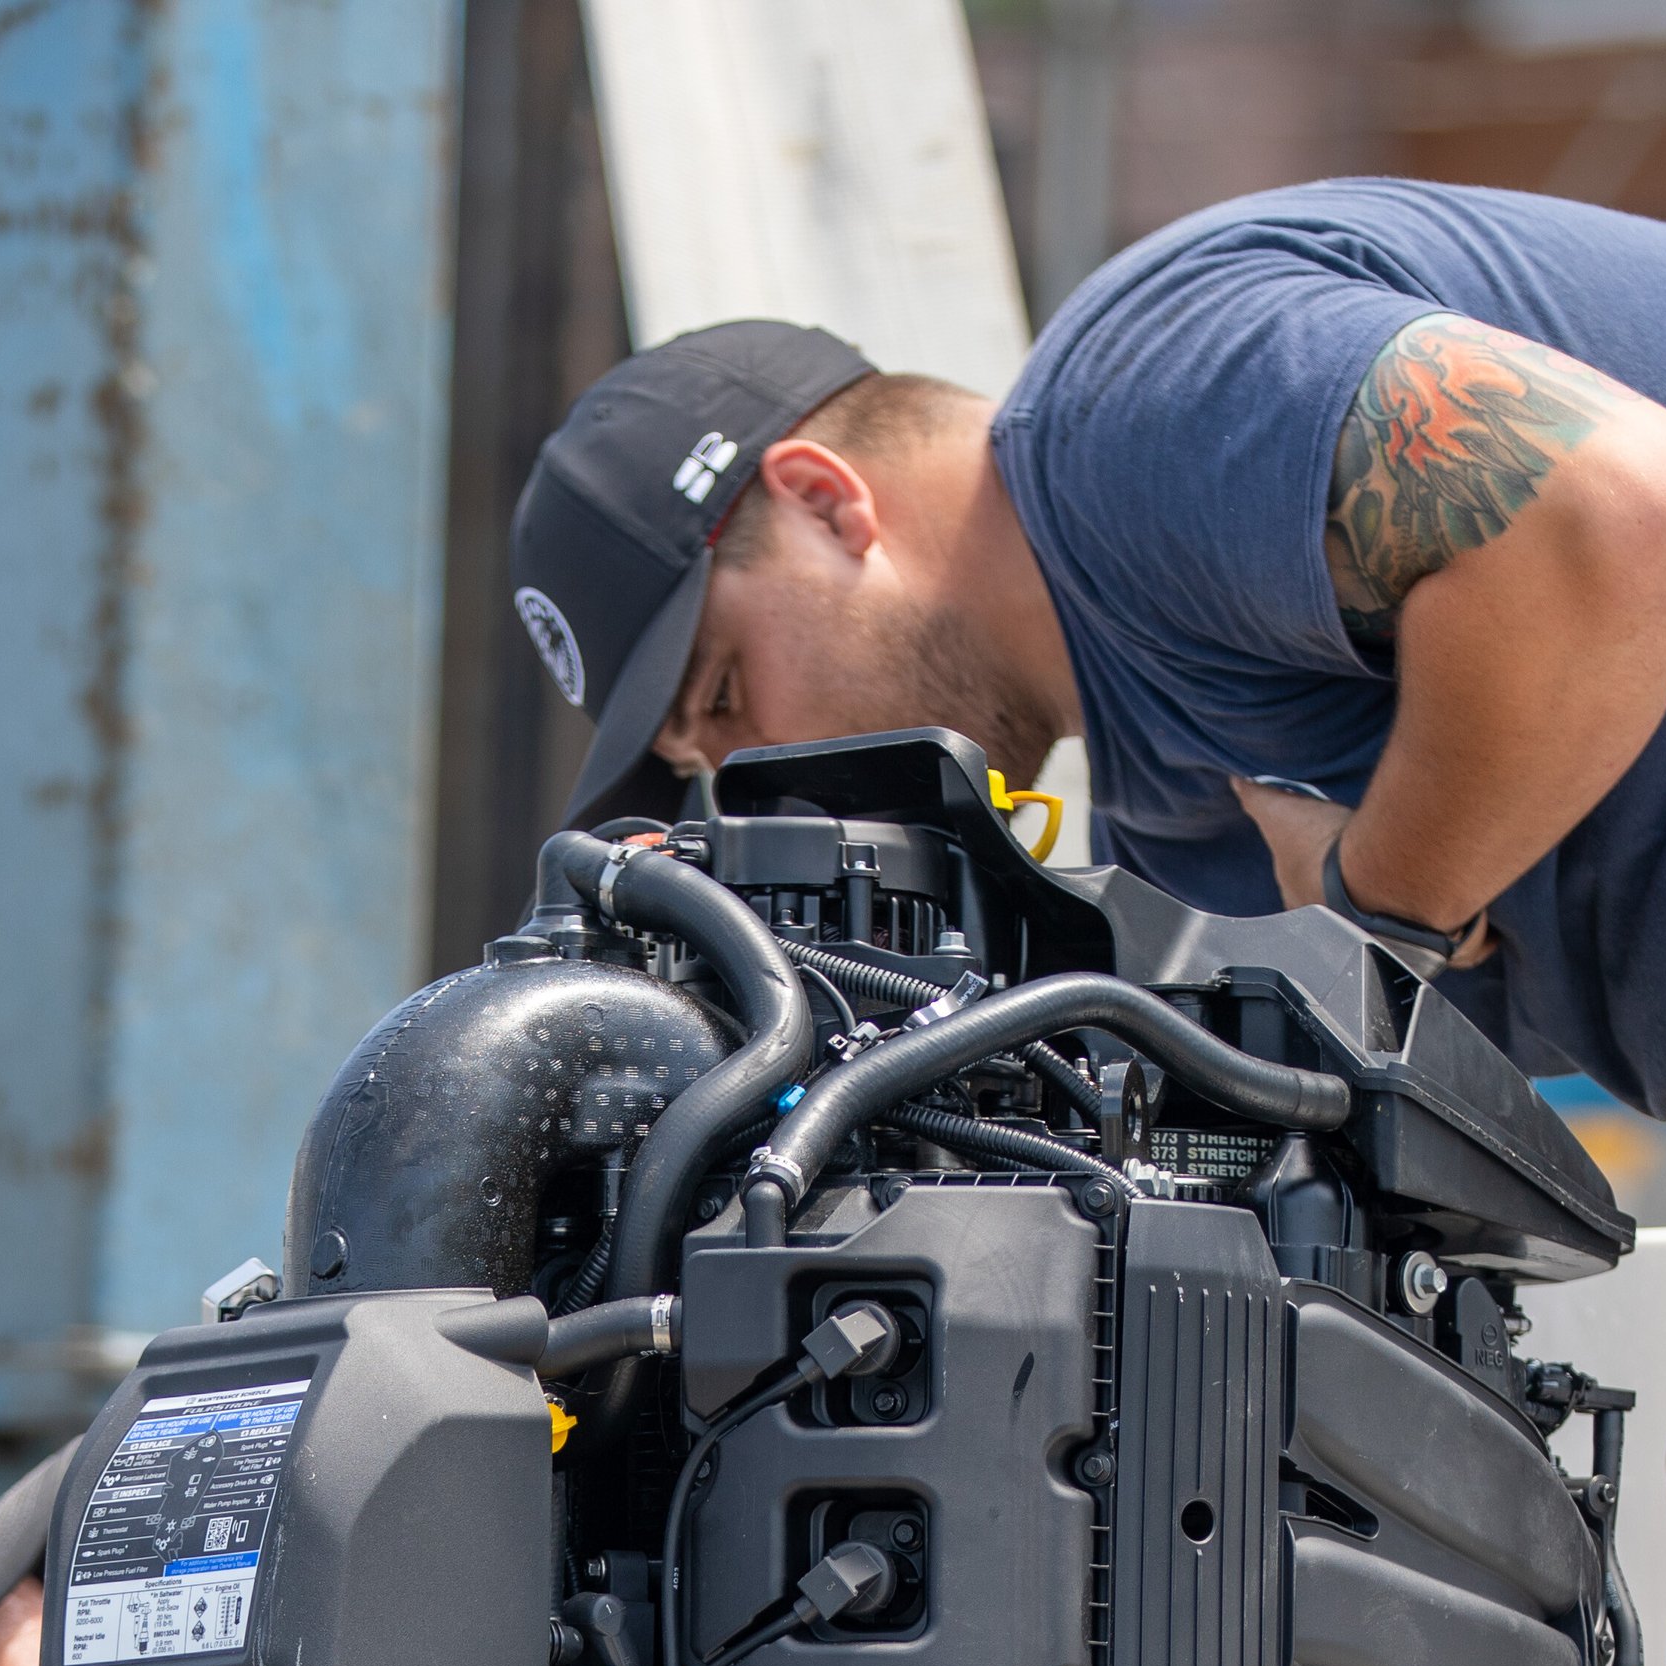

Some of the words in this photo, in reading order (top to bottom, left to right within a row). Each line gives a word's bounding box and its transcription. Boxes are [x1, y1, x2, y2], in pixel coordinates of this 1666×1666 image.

[1151, 1146, 1178, 1160] 373
[1187, 1147, 1258, 1162] STRETCH
[1475, 1348, 1503, 1368] NEG
[197, 1393, 239, 1402] MAINTENANCE
[240, 1389, 272, 1398] SCHEDULE
[182, 1400, 263, 1415] FOURSTROKE
[219, 1413, 240, 1422] EVERY
[252, 1409, 274, 1418] HOURS
[274, 1407, 284, 1415] OF
[284, 1405, 299, 1413] USE
[133, 1424, 155, 1432] EVERY
[167, 1419, 190, 1428] HOURS
[198, 1415, 214, 1424] USE
[251, 1416, 272, 1425] THREE
[273, 1413, 294, 1422] YEARS
[140, 1430, 159, 1438] ONCE
[159, 1427, 184, 1436] YEARLY
[249, 1425, 283, 1436] REPLACE
[139, 1440, 173, 1449] REPLACE
[240, 1443, 255, 1452] Spark
[136, 1453, 153, 1461] Engine
[153, 1451, 162, 1459] Oil
[133, 1459, 143, 1467] and
[233, 1459, 244, 1467] Low
[244, 1457, 265, 1465] Pressure
[239, 1464, 252, 1472] Fuel
[121, 1474, 144, 1483] Gearcase
[144, 1471, 167, 1480] Lubricant
[210, 1481, 235, 1490] Accessory
[234, 1479, 247, 1487] Drive
[119, 1487, 152, 1498] INSPECT
[217, 1500, 232, 1508] Pump
[231, 1497, 251, 1506] Impeller
[108, 1507, 127, 1515] Anodes
[102, 1526, 129, 1535] Thermostat
[96, 1549, 112, 1557] Spark
[104, 1568, 125, 1577] Pressure
[125, 1566, 136, 1575] Fuel
[136, 1565, 149, 1574] Filter
[144, 1578, 183, 1588] Specifications
[215, 1583, 232, 1593] Engine
[90, 1598, 111, 1606] Throttle
[157, 1598, 170, 1606] Apply
[74, 1634, 94, 1642] Neutral
[94, 1632, 106, 1640] Idle
[71, 1653, 83, 1661] 600
